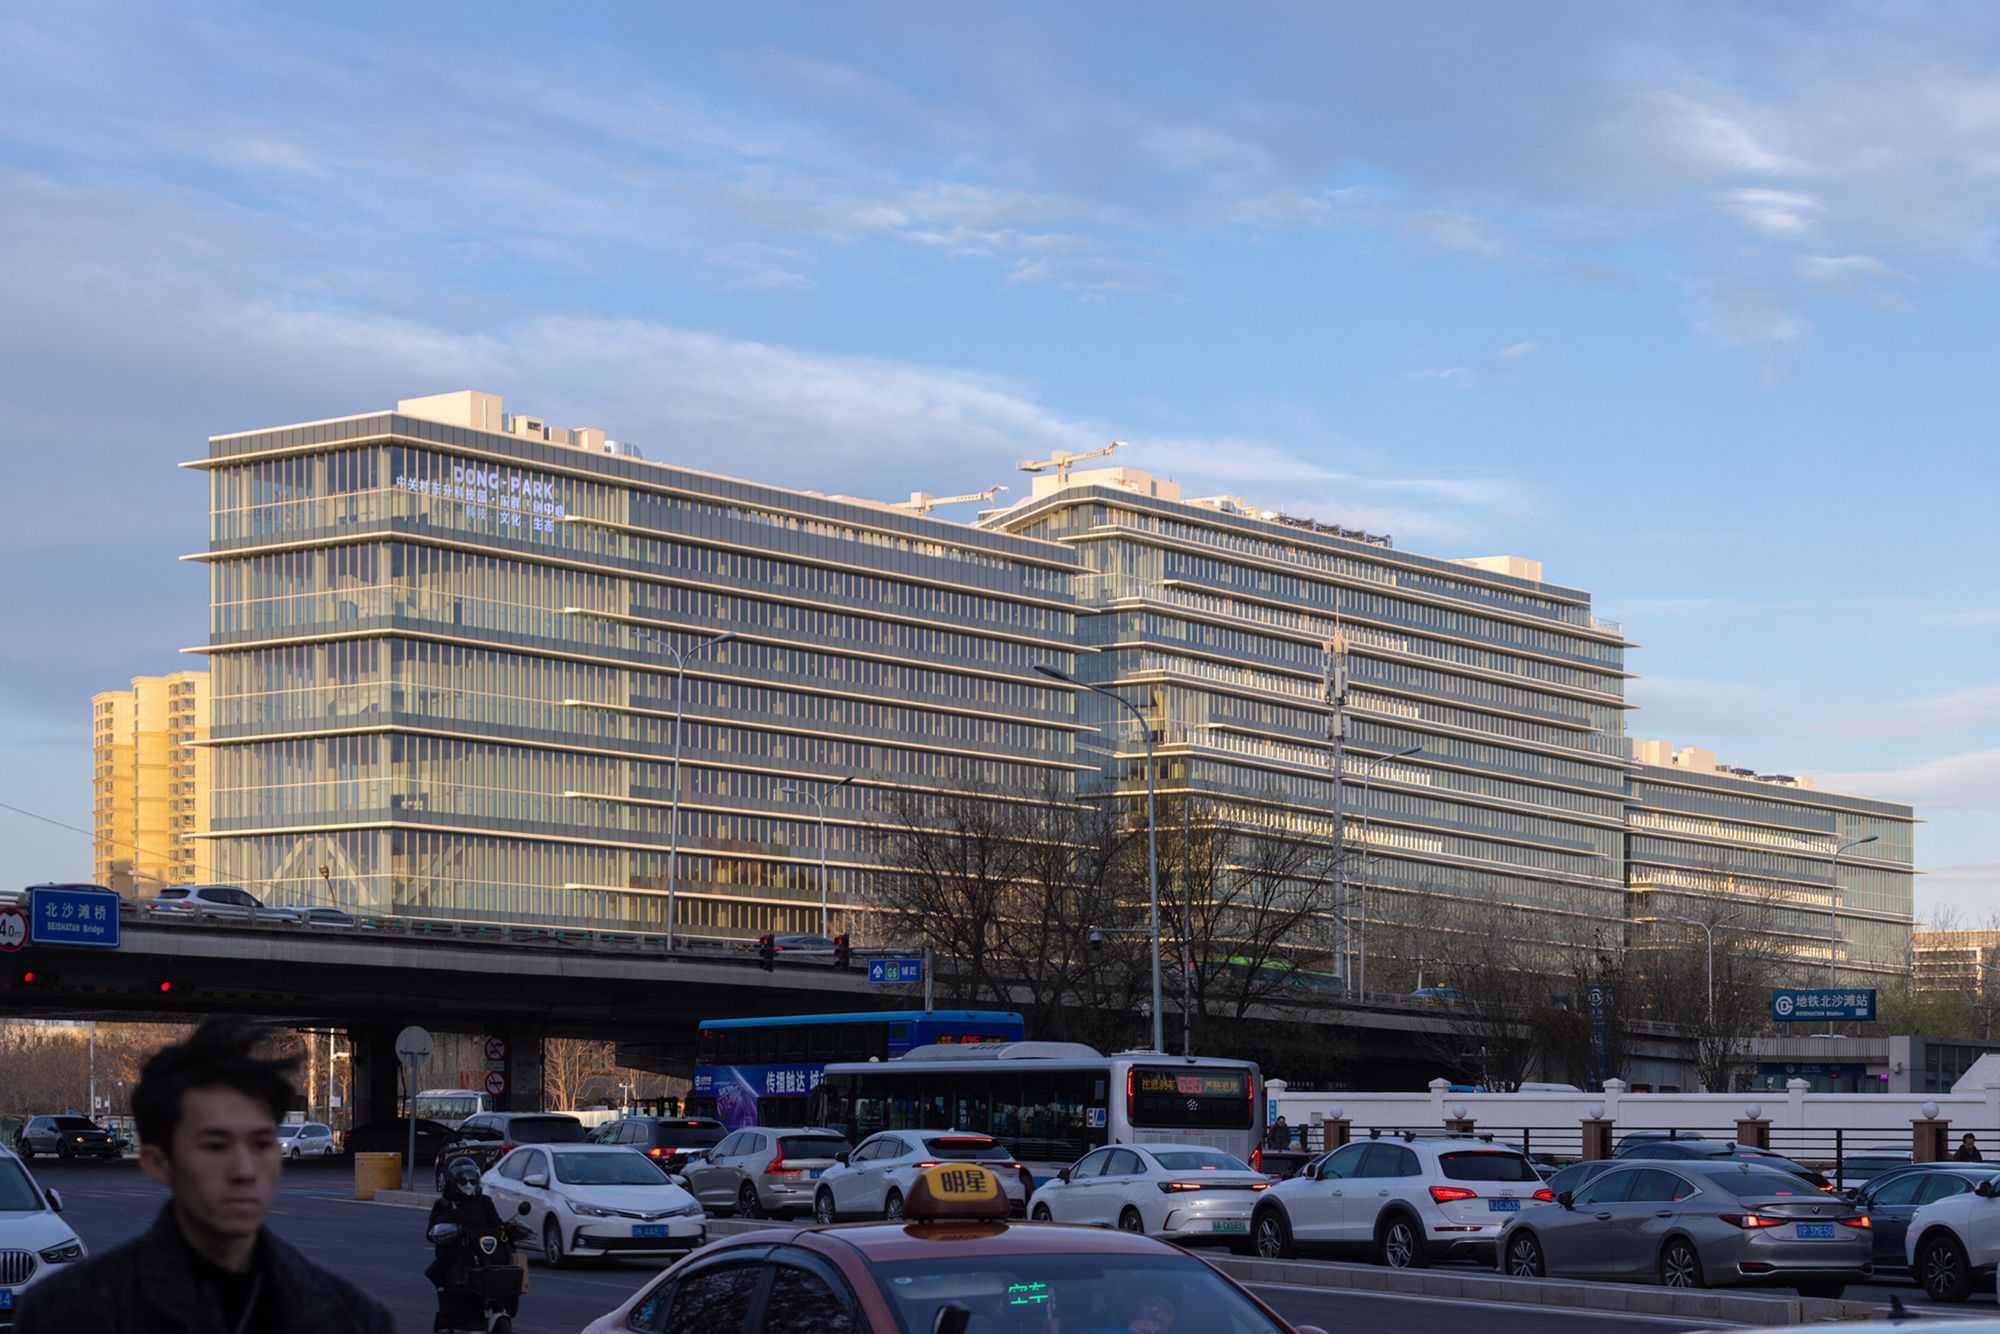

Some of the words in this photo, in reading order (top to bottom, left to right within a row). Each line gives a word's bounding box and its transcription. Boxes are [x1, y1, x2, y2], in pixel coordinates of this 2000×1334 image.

[45, 902, 106, 920] 北沙滩桥
[47, 921, 80, 932] BEISHATAN
[83, 924, 104, 935] Bridge
[887, 967, 897, 978] G6
[1795, 994, 1868, 1008] 地铁北沙滩站
[766, 1070, 806, 1094] 传播触达
[1178, 1076, 1202, 1094] 695
[941, 1170, 988, 1193] 明星
